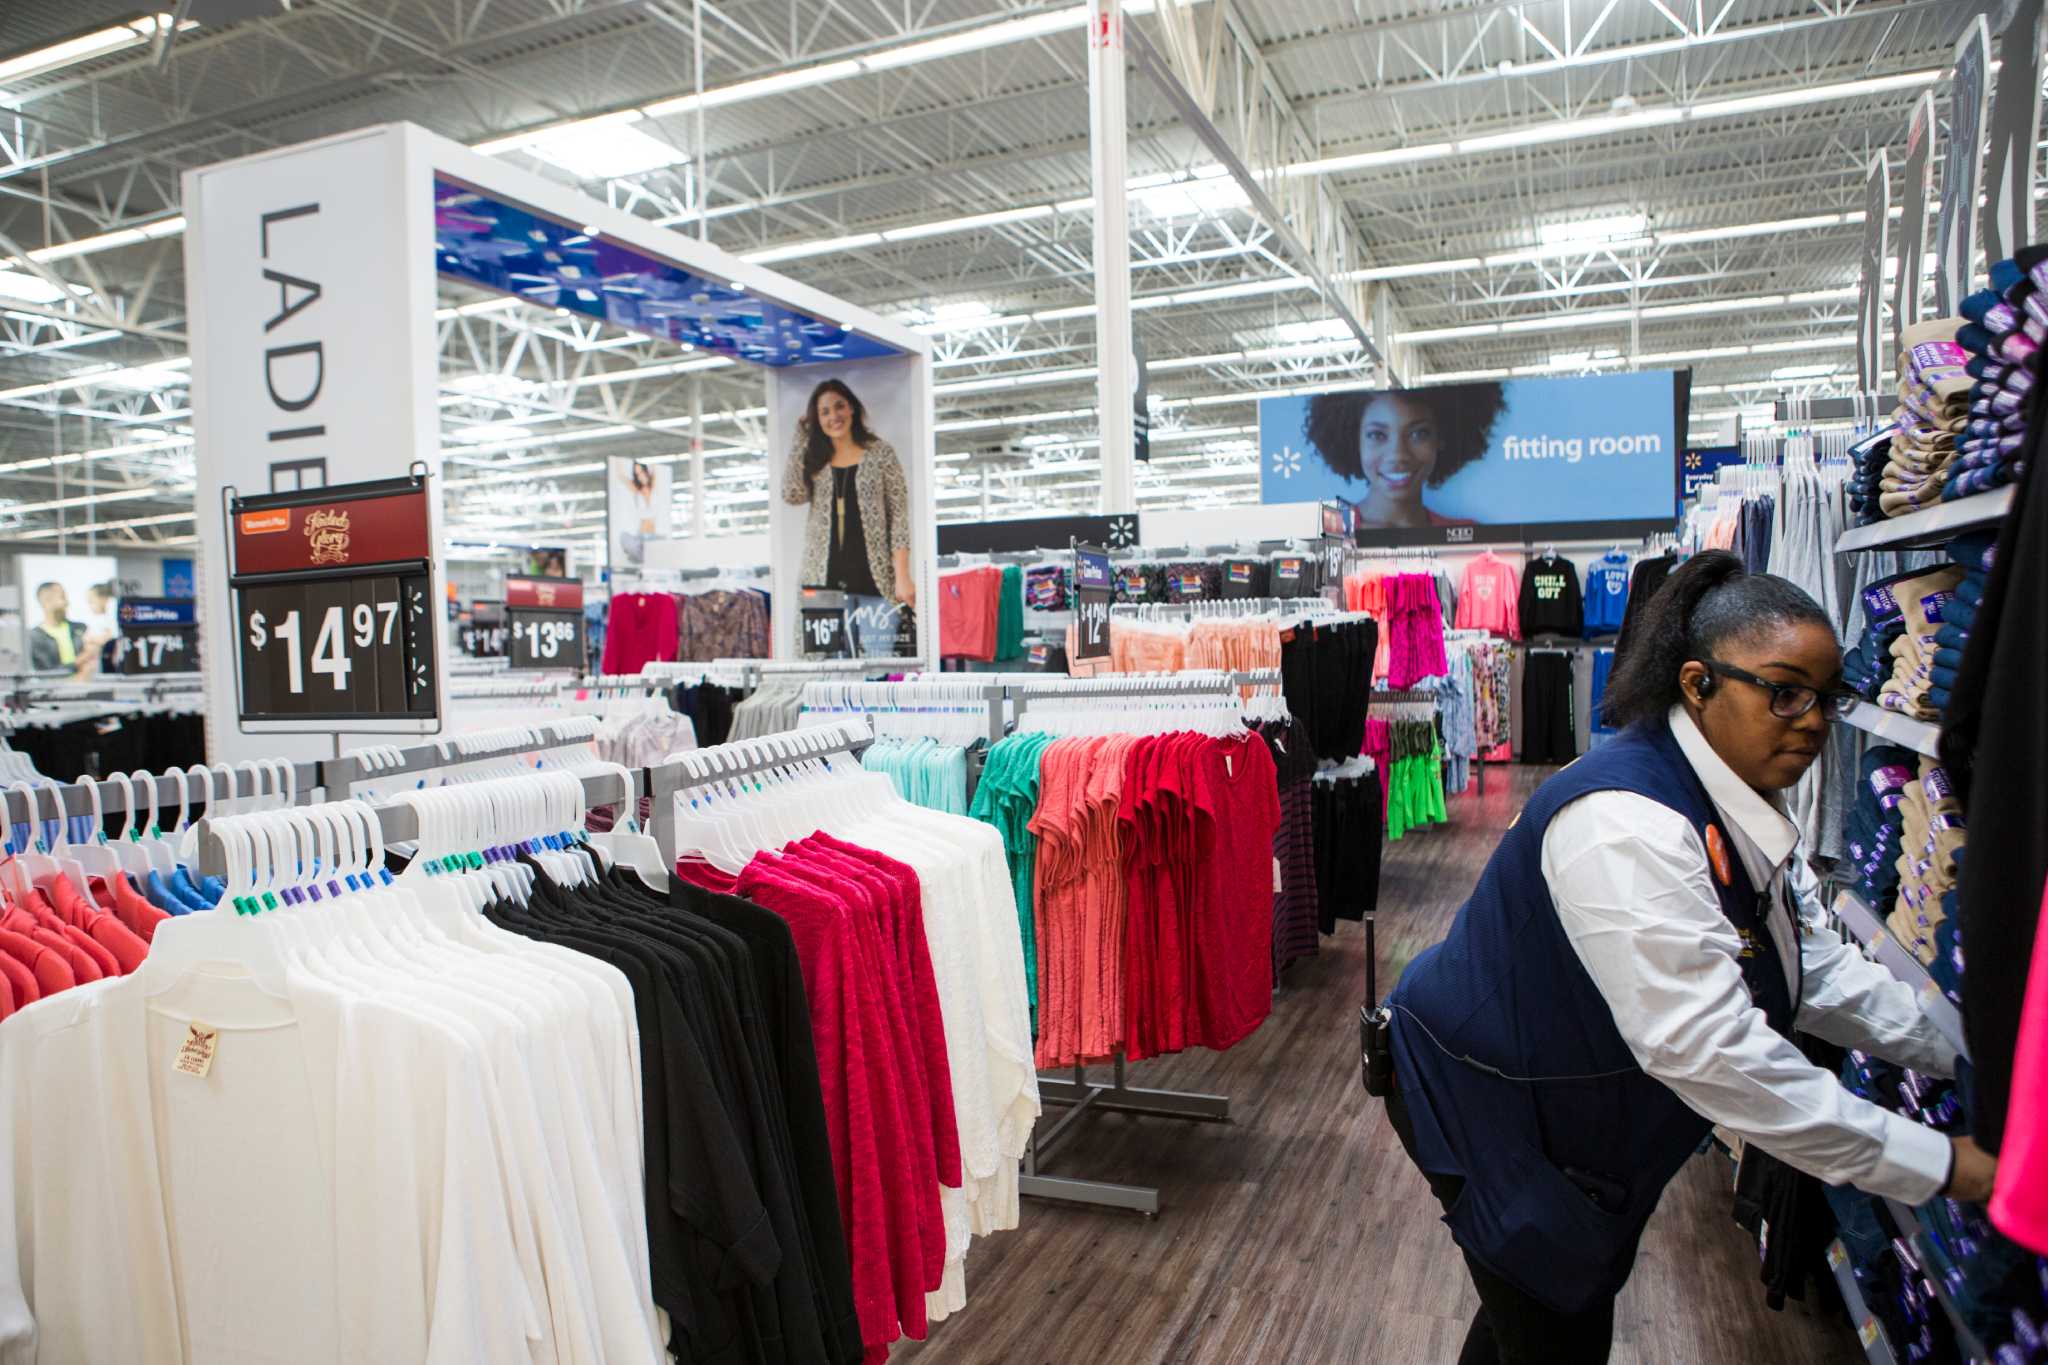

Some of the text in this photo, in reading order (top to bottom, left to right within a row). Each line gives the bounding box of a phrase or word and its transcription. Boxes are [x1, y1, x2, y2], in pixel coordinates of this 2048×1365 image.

[260, 202, 327, 494] LADIE
[1502, 434, 1661, 462] fitting room
[1534, 575, 1566, 588] CHILL
[1537, 588, 1561, 599] OUT
